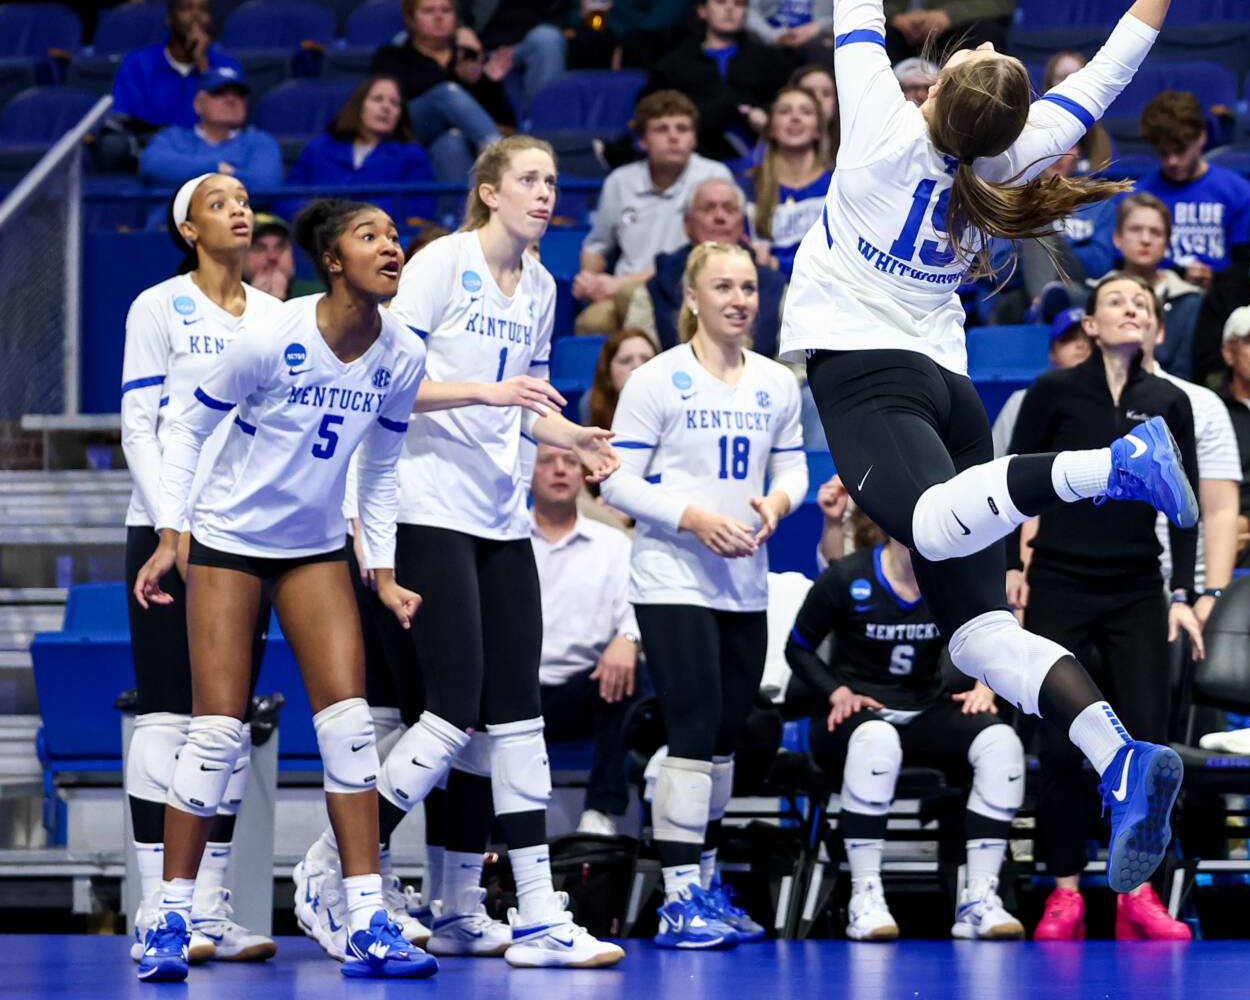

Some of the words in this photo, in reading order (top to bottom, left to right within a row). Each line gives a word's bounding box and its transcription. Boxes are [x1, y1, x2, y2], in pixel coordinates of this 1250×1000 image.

[1175, 202, 1225, 224] BLUE
[287, 385, 387, 414] KENTUCKY
[686, 409, 772, 432] KENTUCKY
[311, 414, 345, 460] 5
[718, 434, 750, 480] 18
